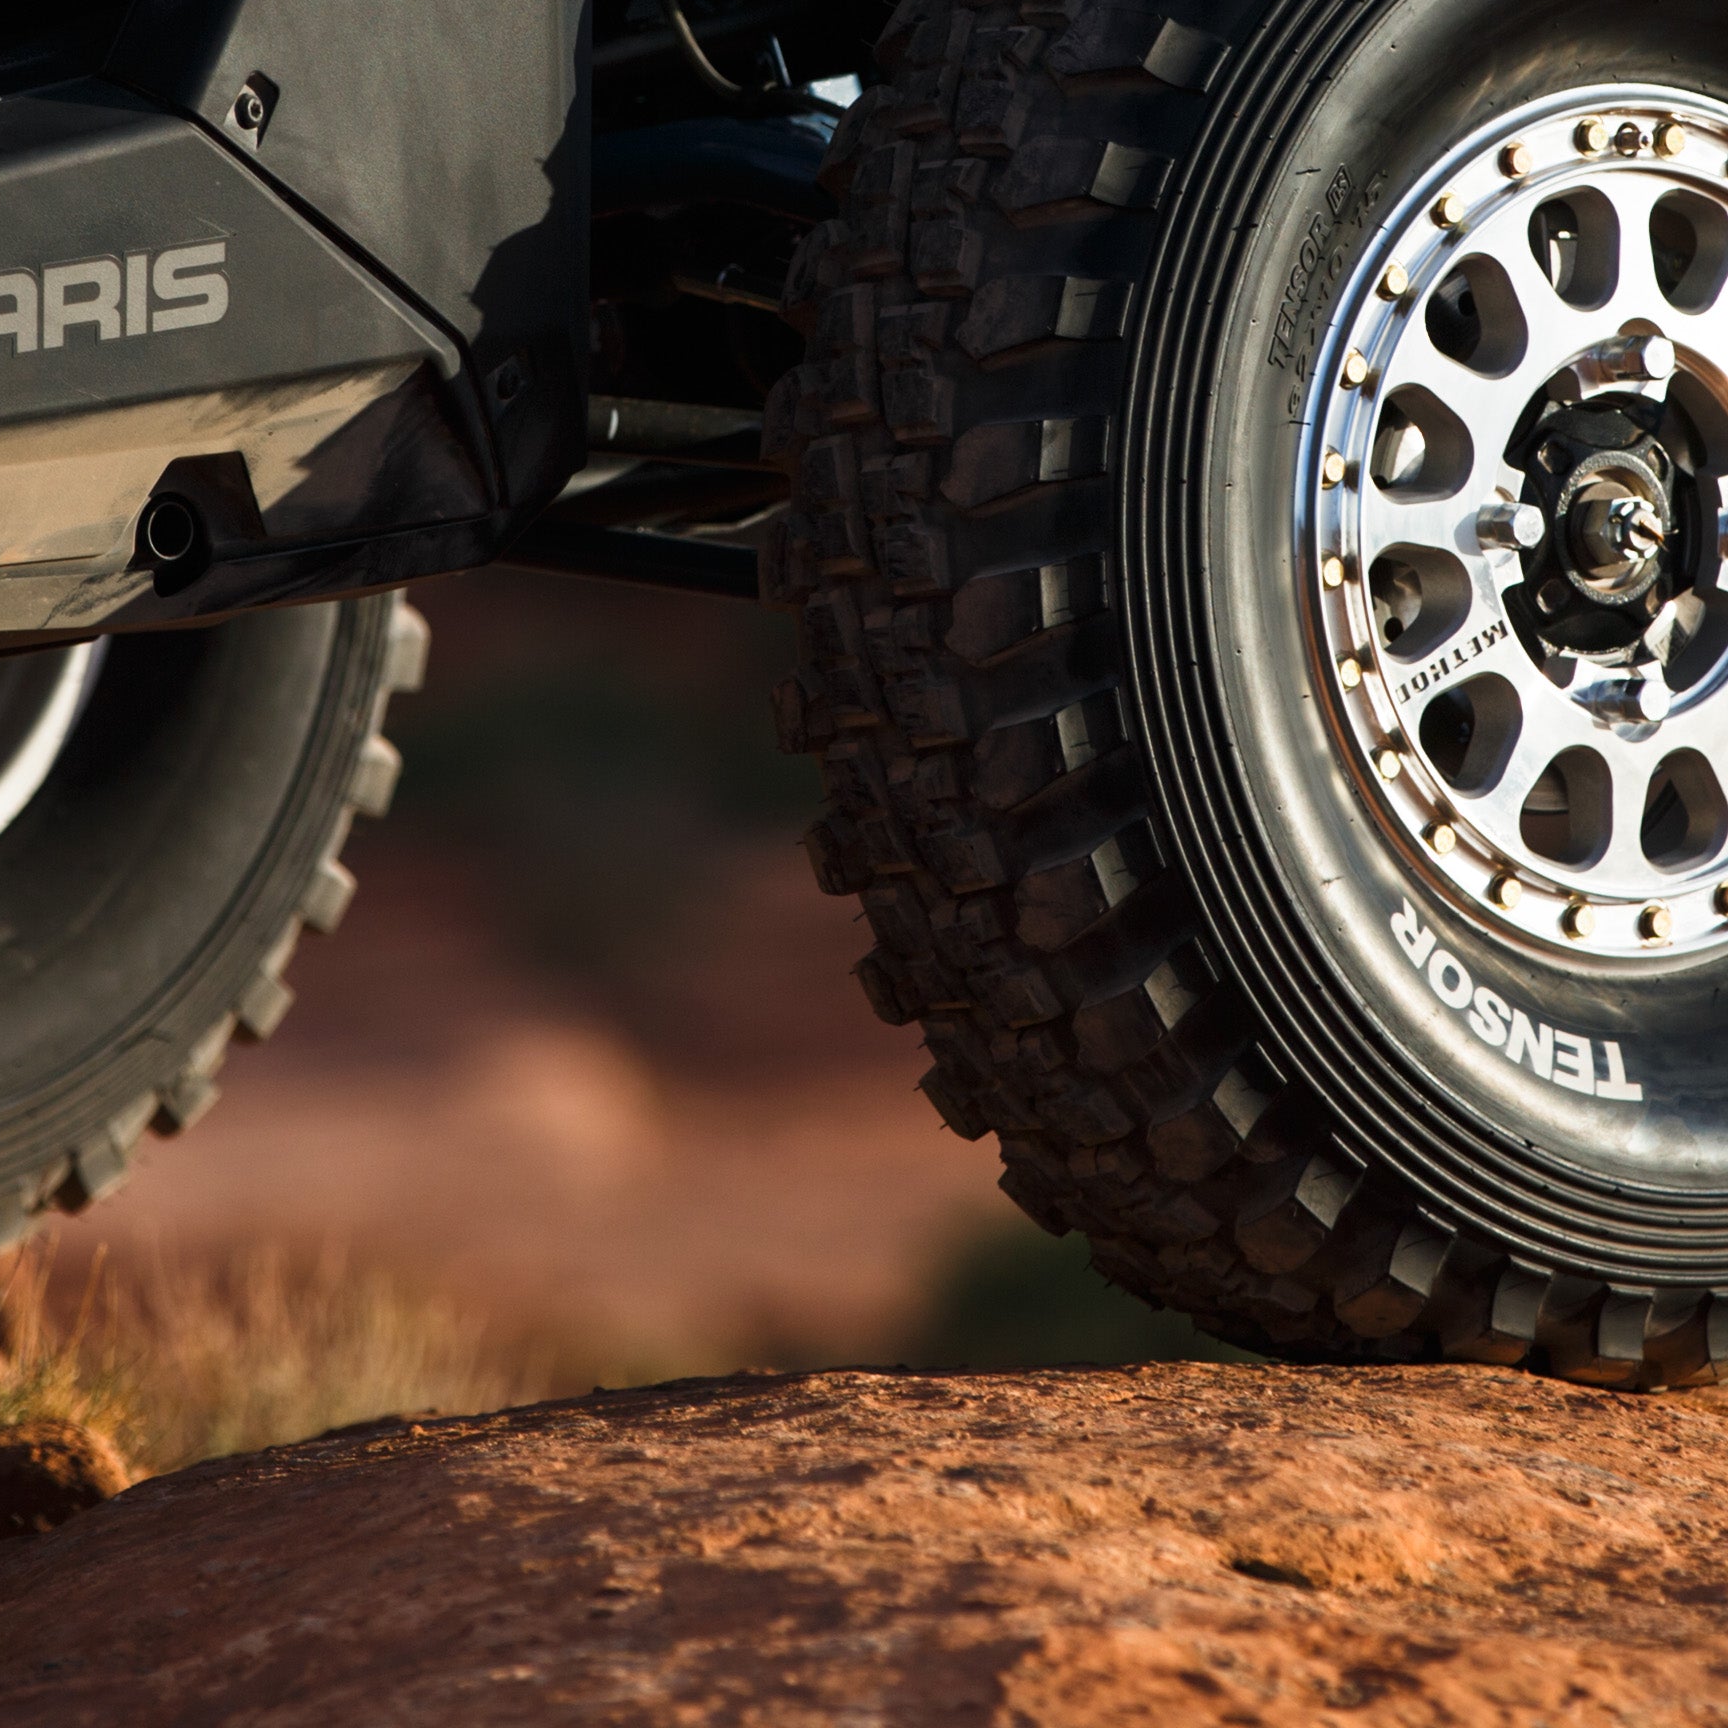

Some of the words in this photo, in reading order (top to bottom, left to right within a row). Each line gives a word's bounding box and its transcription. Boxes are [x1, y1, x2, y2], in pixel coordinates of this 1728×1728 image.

[1268, 211, 1332, 370] TENSOR
[1395, 619, 1510, 705] METHOD
[1390, 896, 1643, 1101] TENSOR
